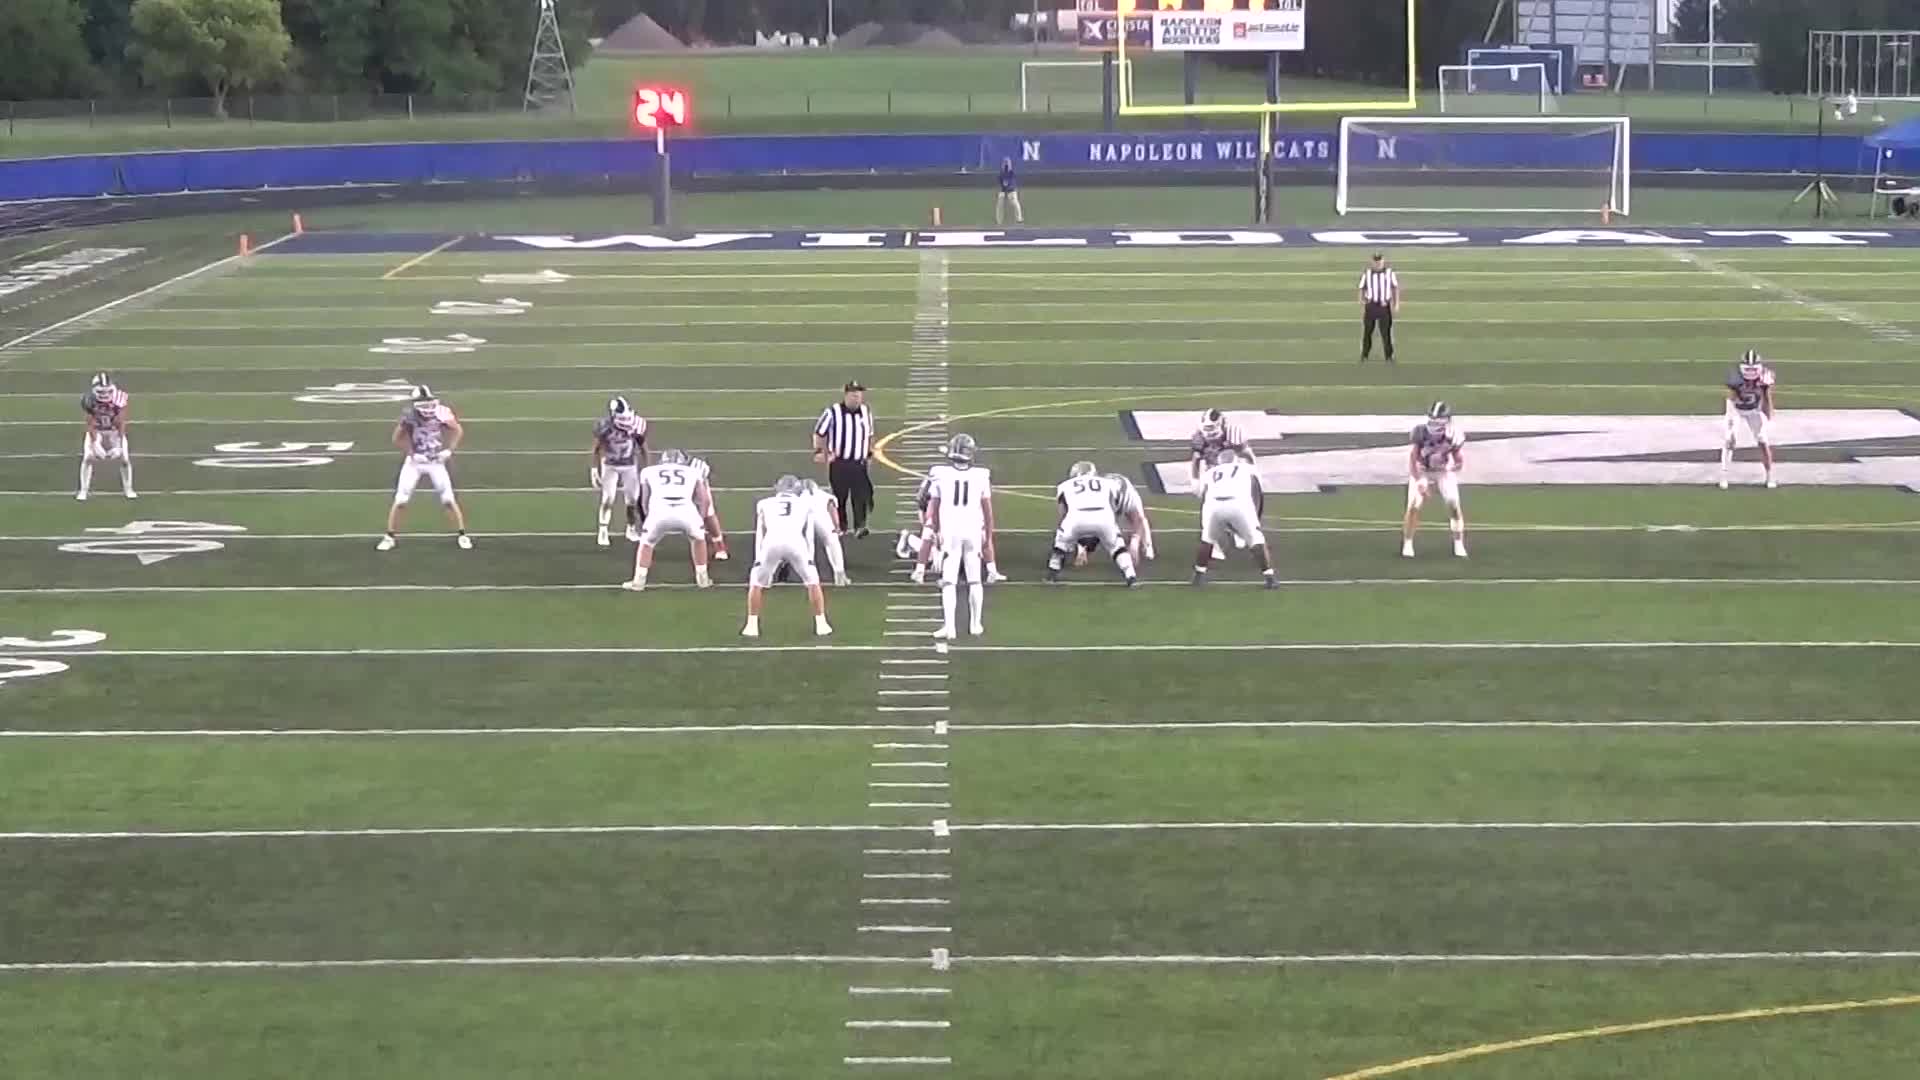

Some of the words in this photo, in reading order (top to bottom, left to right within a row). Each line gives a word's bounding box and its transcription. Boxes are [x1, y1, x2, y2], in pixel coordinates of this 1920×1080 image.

[1160, 18, 1222, 26] NAPOLEON
[1163, 26, 1220, 35] ATHLETIC
[636, 89, 684, 127] 24
[1023, 141, 1041, 161] N
[1089, 143, 1203, 161] NAPOLEON
[1216, 141, 1329, 159] WILCATS
[1377, 138, 1398, 159] N
[659, 469, 685, 486] 55
[953, 479, 969, 507] 11
[1073, 479, 1102, 495] 50
[778, 501, 792, 517] 3
